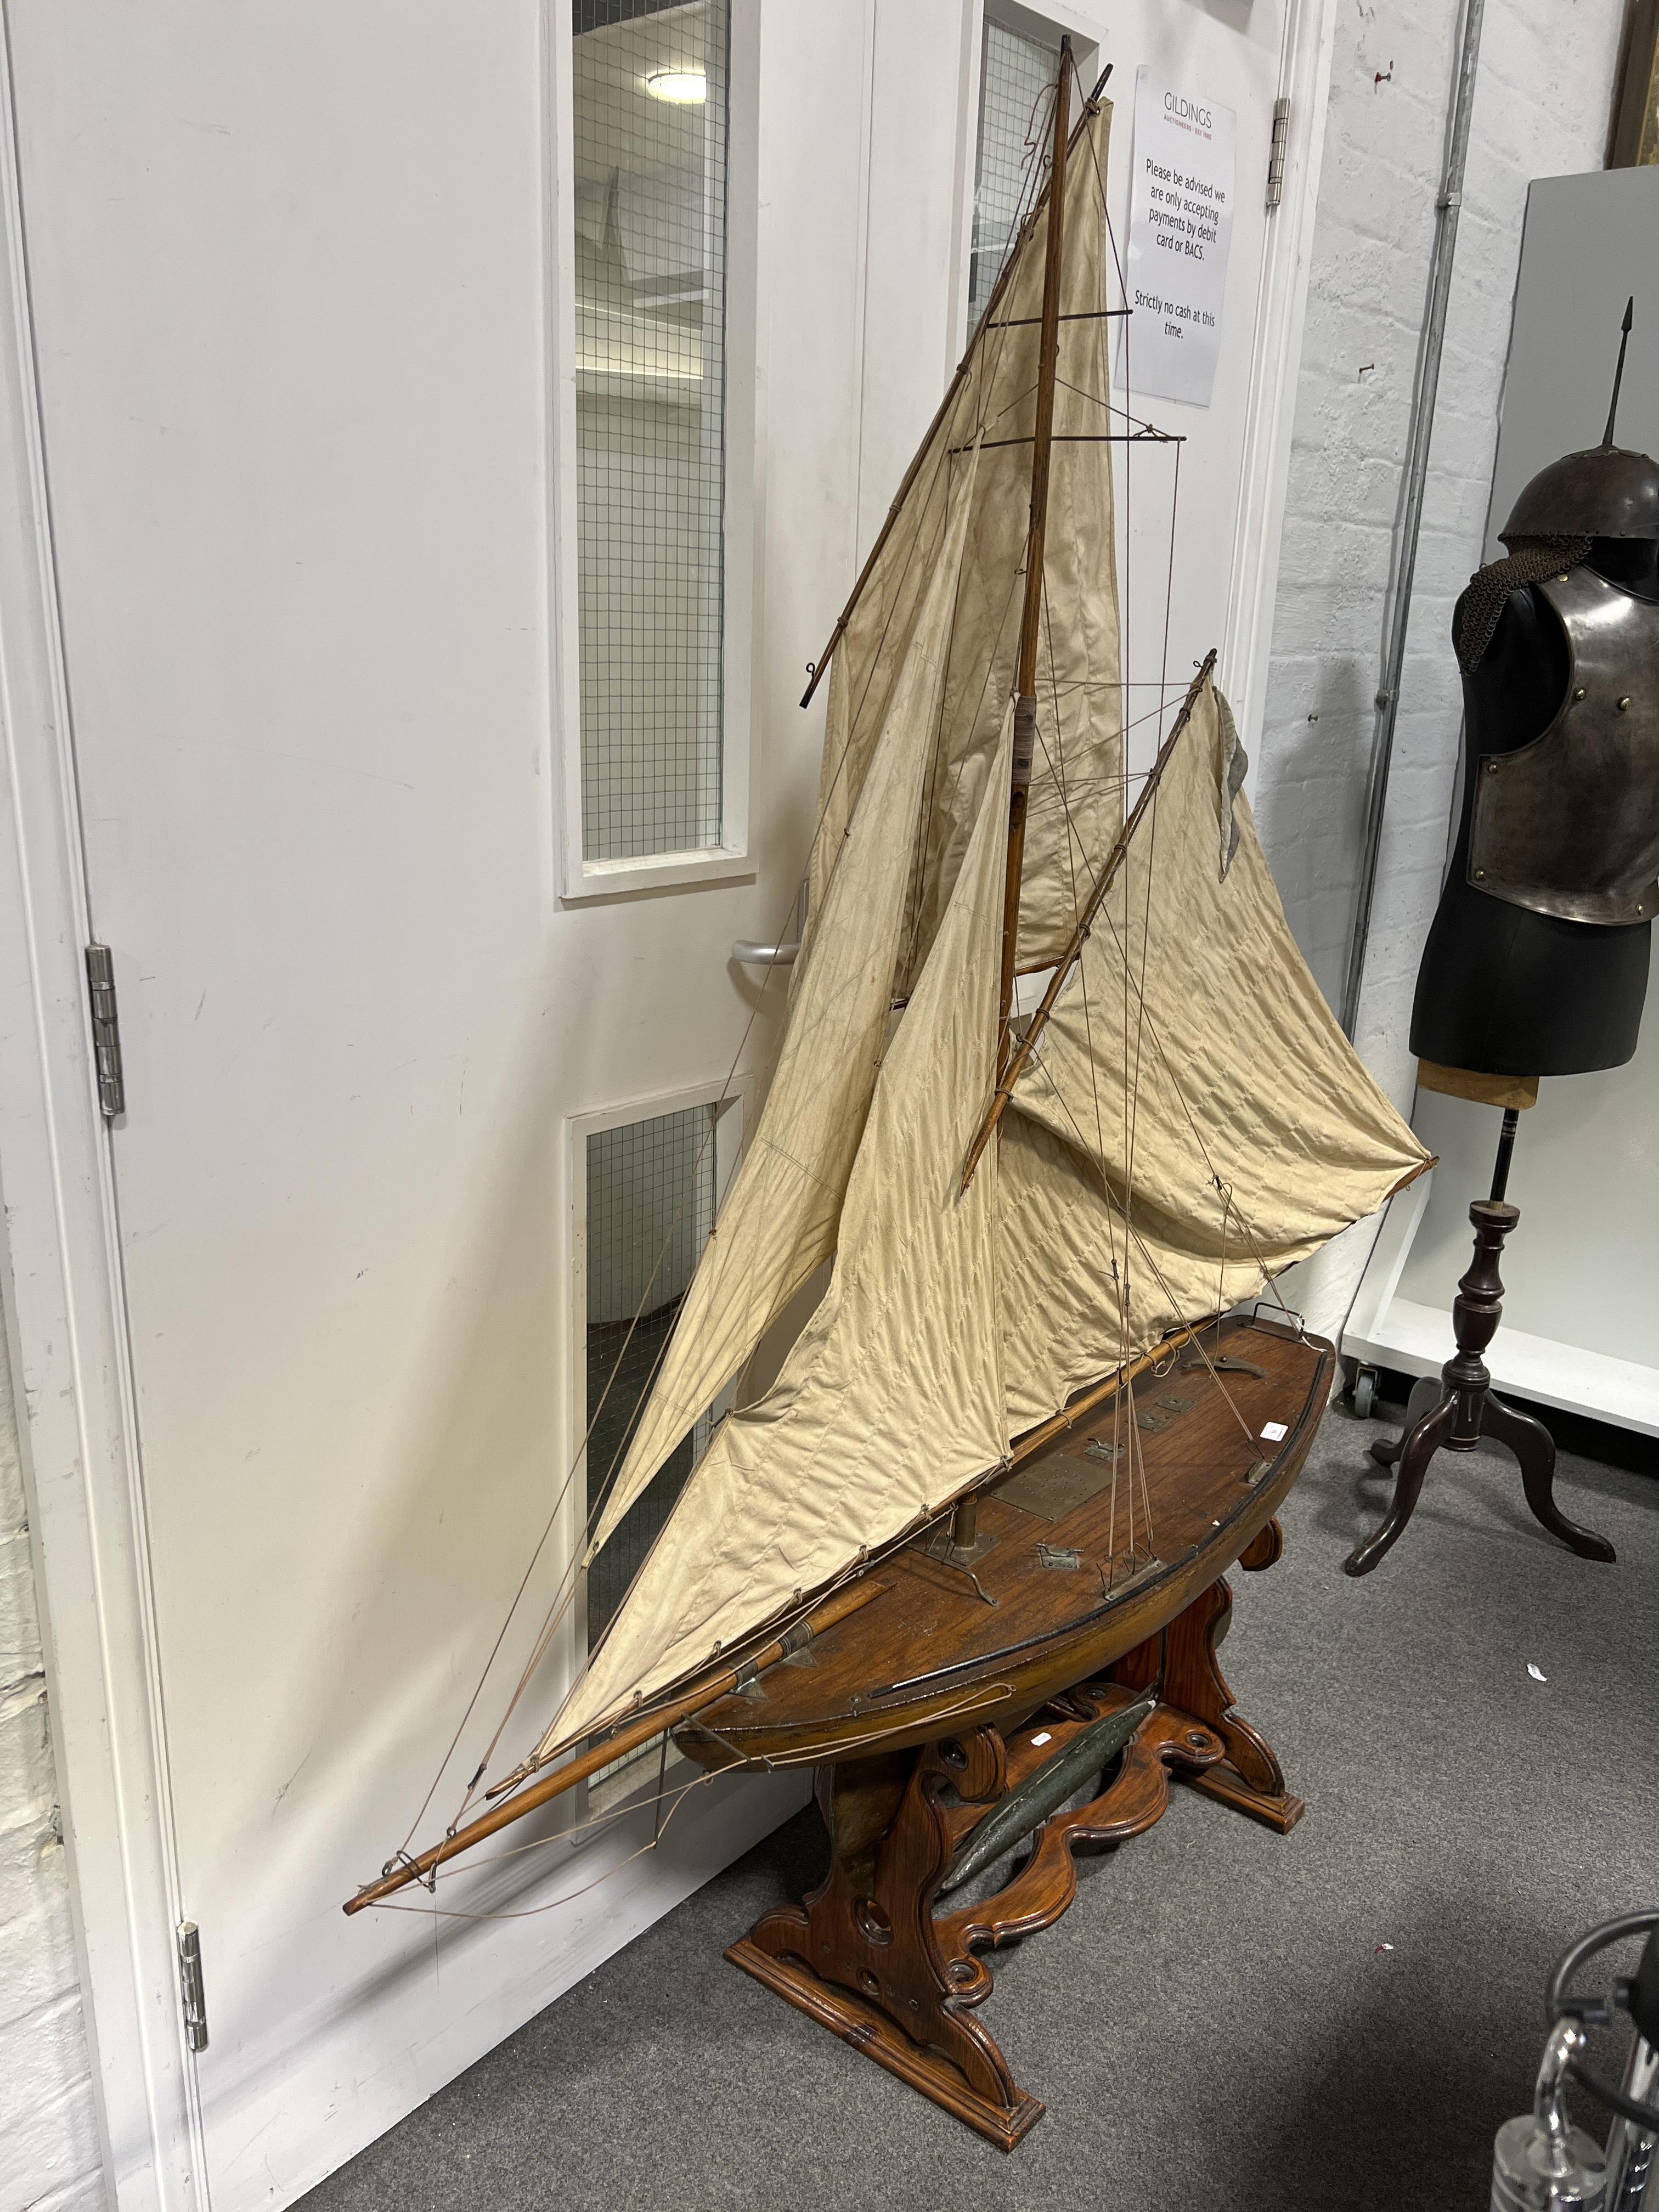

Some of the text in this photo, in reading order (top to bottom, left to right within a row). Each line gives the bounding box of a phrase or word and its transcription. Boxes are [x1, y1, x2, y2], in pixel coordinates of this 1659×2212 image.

[1164, 92, 1212, 128] GILDINGS
[1164, 114, 1192, 132] AUCTIONEERS
[1146, 158, 1226, 203] Please be advised we
[1150, 186, 1220, 225] are only accepting
[1149, 208, 1217, 243] payments by debit
[1156, 234, 1205, 261] card or BACS.
[1135, 290, 1215, 327] Strictly no cash at this
[1165, 321, 1183, 338] time.
